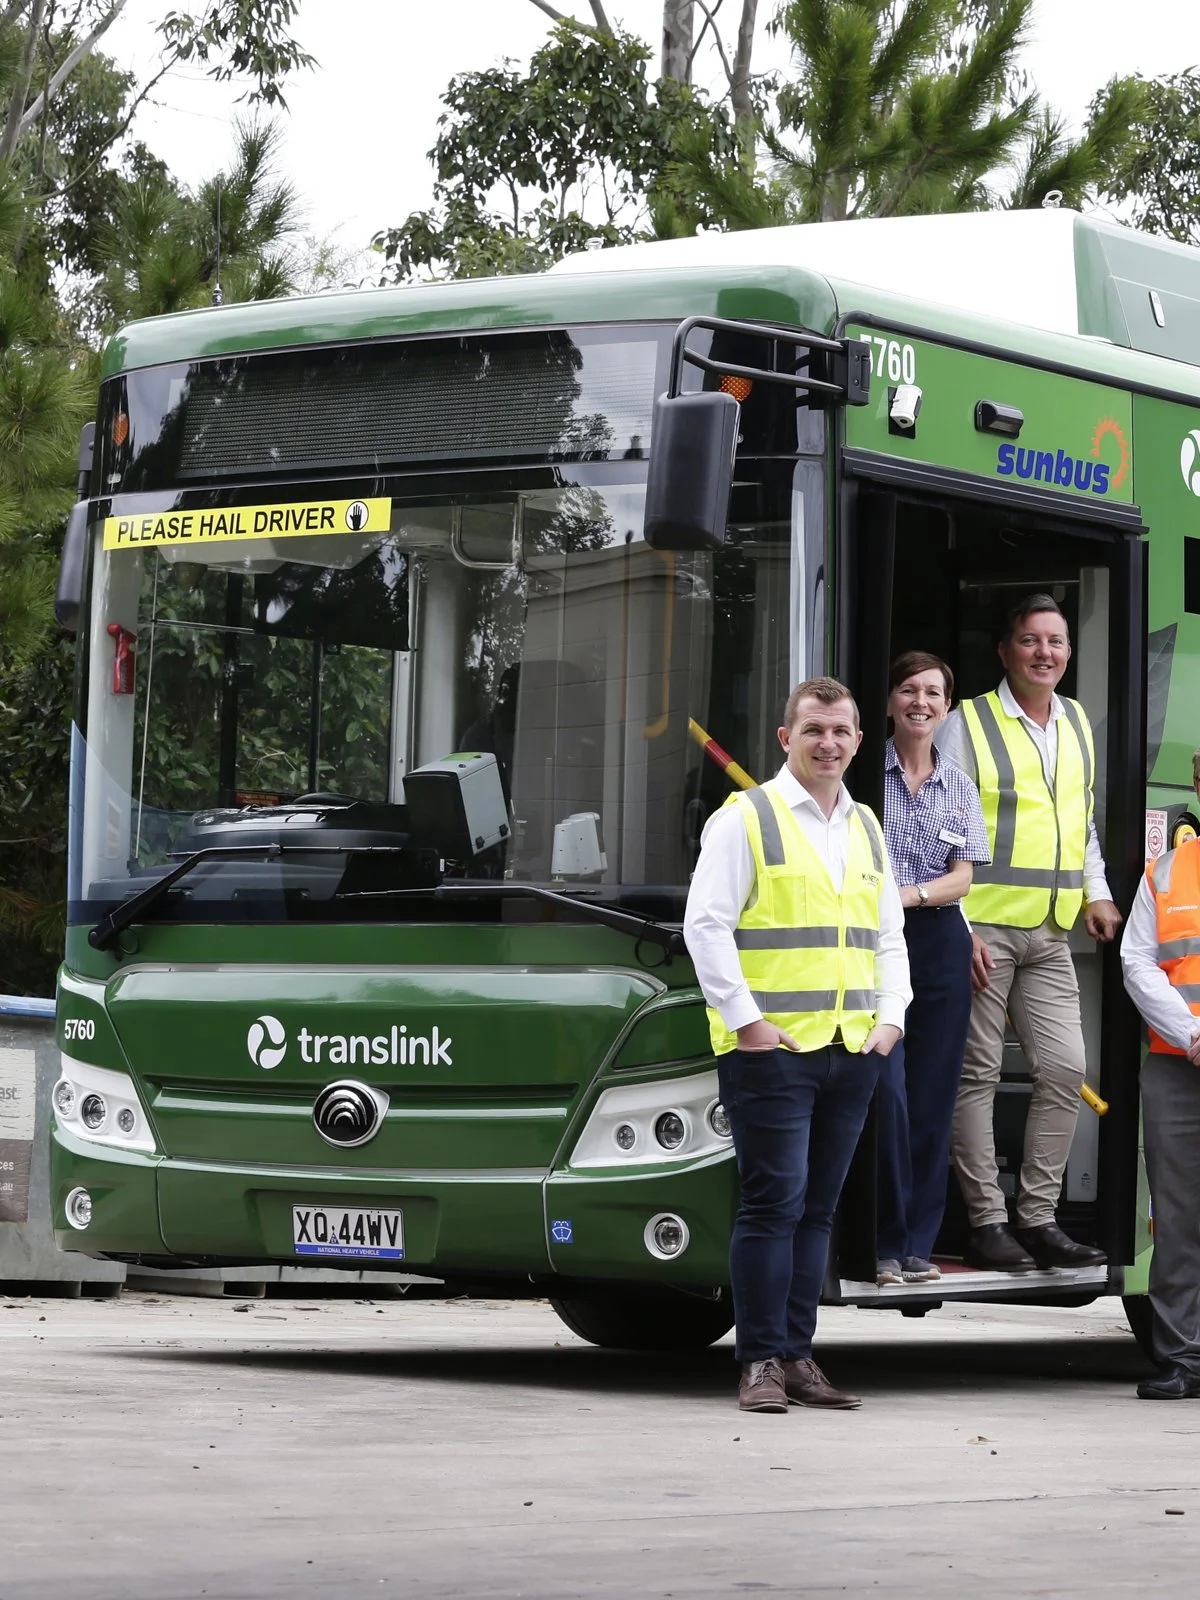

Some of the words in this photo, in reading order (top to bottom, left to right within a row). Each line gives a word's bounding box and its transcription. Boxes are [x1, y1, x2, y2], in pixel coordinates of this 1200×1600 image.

[996, 443, 1110, 495] sunbus
[117, 516, 194, 543] PLEASE
[199, 512, 247, 536] HAIL
[253, 506, 335, 533] DRIVER
[64, 1019, 95, 1040] 5760
[297, 1025, 453, 1066] translink
